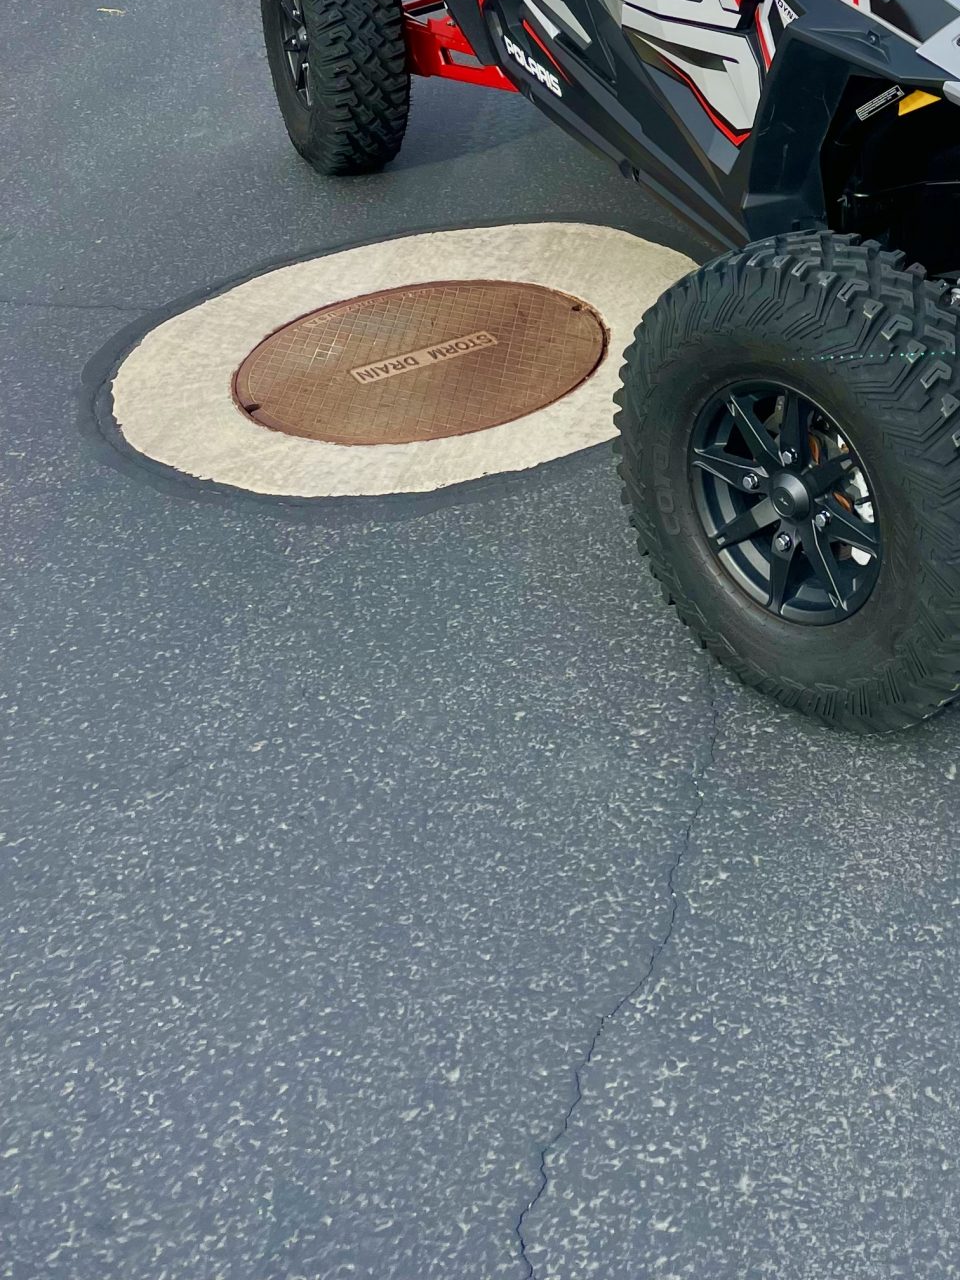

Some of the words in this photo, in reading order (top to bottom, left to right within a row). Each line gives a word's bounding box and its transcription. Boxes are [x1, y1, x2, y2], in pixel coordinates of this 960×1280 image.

[503, 34, 562, 98] POLARIS
[427, 333, 493, 361] STORM
[355, 355, 420, 382] DRAIN
